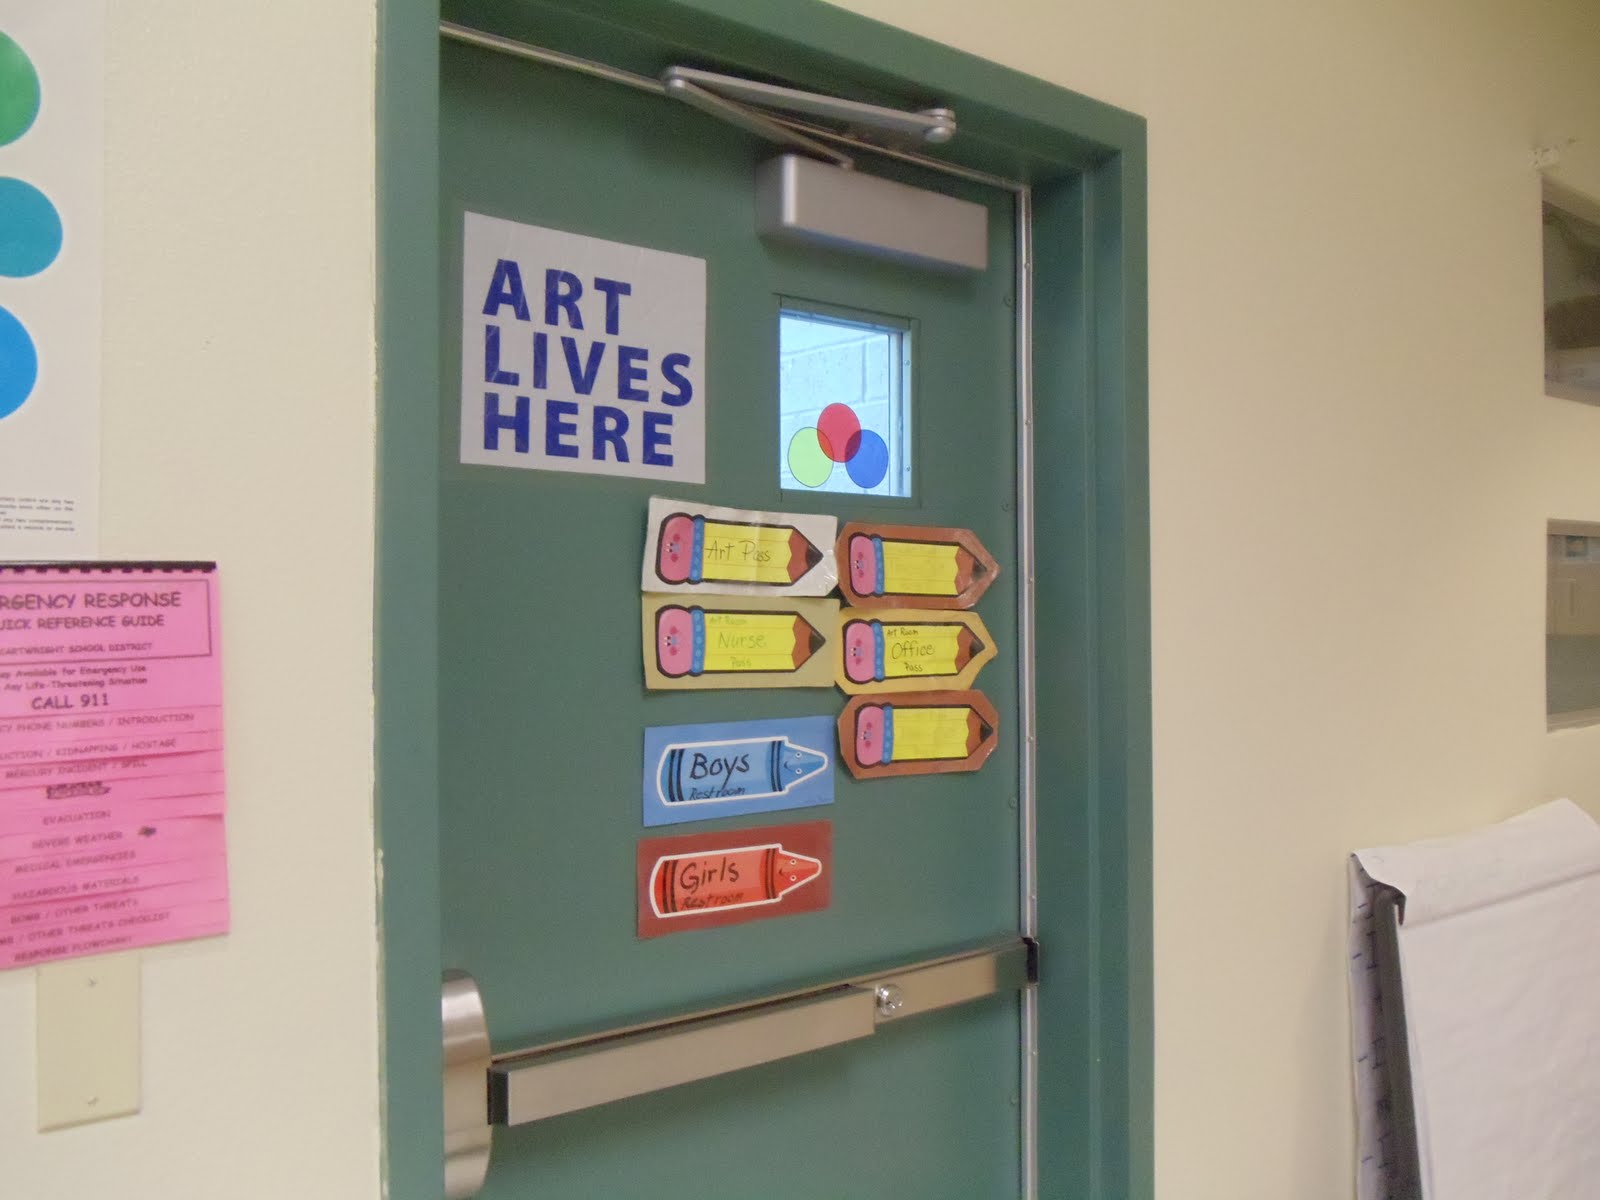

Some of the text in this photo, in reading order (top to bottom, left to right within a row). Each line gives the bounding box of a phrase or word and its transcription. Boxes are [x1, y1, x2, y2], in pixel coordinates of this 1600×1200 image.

[482, 258, 632, 336] ART
[484, 324, 693, 407] LIVES
[483, 391, 674, 467] HERE
[704, 540, 771, 562] Art Pass
[84, 591, 182, 608] RESPONSE
[37, 615, 116, 629] REFERENCE
[121, 614, 165, 627] GUIDE
[900, 627, 919, 636] Room
[68, 643, 105, 653] SCHOOL
[108, 642, 153, 652] DISTRICT
[718, 632, 767, 649] Nurse
[891, 640, 935, 660] Office
[730, 656, 752, 667] Pass
[904, 662, 923, 672] Pass
[62, 666, 76, 675] for
[80, 665, 127, 675] Emergency
[130, 664, 146, 673] Use
[4, 683, 22, 692] Any
[108, 677, 148, 686] Situation
[31, 693, 109, 710] CALL 911
[117, 712, 194, 726] INTRODUCTION
[689, 752, 750, 790] Boys
[689, 786, 745, 800] Restroom
[42, 810, 112, 825] EVACUATION
[74, 831, 123, 844] WEATHER
[680, 857, 740, 894] Girls
